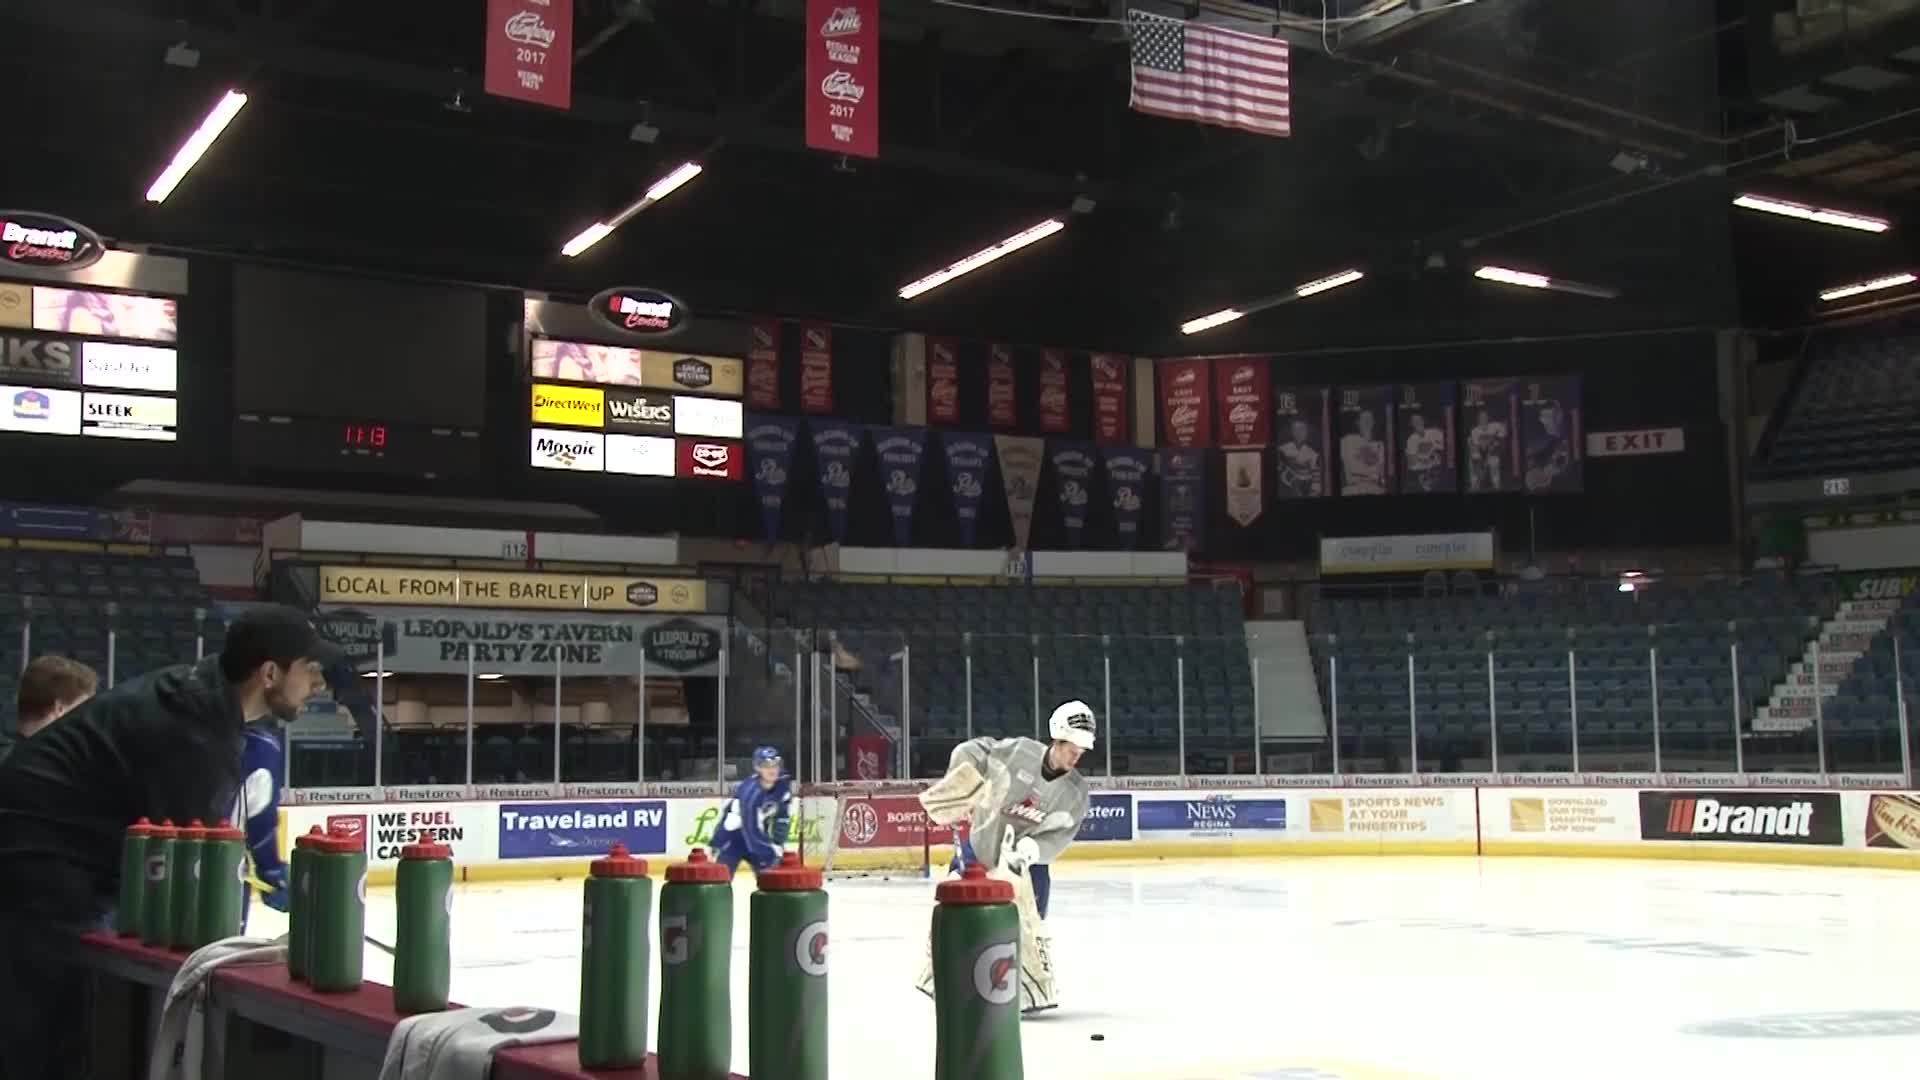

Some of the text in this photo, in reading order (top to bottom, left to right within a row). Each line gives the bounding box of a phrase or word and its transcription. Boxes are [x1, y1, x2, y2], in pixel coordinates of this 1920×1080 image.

[517, 48, 546, 65] 2017
[830, 103, 854, 118] 2017
[536, 438, 597, 455] Mosaic
[1605, 432, 1665, 451] EXIT
[325, 576, 615, 601] LOCAL FROM THE BARLEY UP
[404, 619, 633, 643] LEOPOLD'S TAVERN
[440, 641, 602, 664] PARTY ZONE
[1186, 802, 1237, 819] NEWS
[1349, 796, 1445, 808] SPORTS NEWS
[378, 812, 453, 827] WE FUEL
[502, 810, 628, 831] Traveland
[634, 808, 663, 827] RV
[1349, 809, 1408, 819] AT YOUR
[1693, 798, 1814, 837] Brandt
[973, 941, 1017, 1004] G
